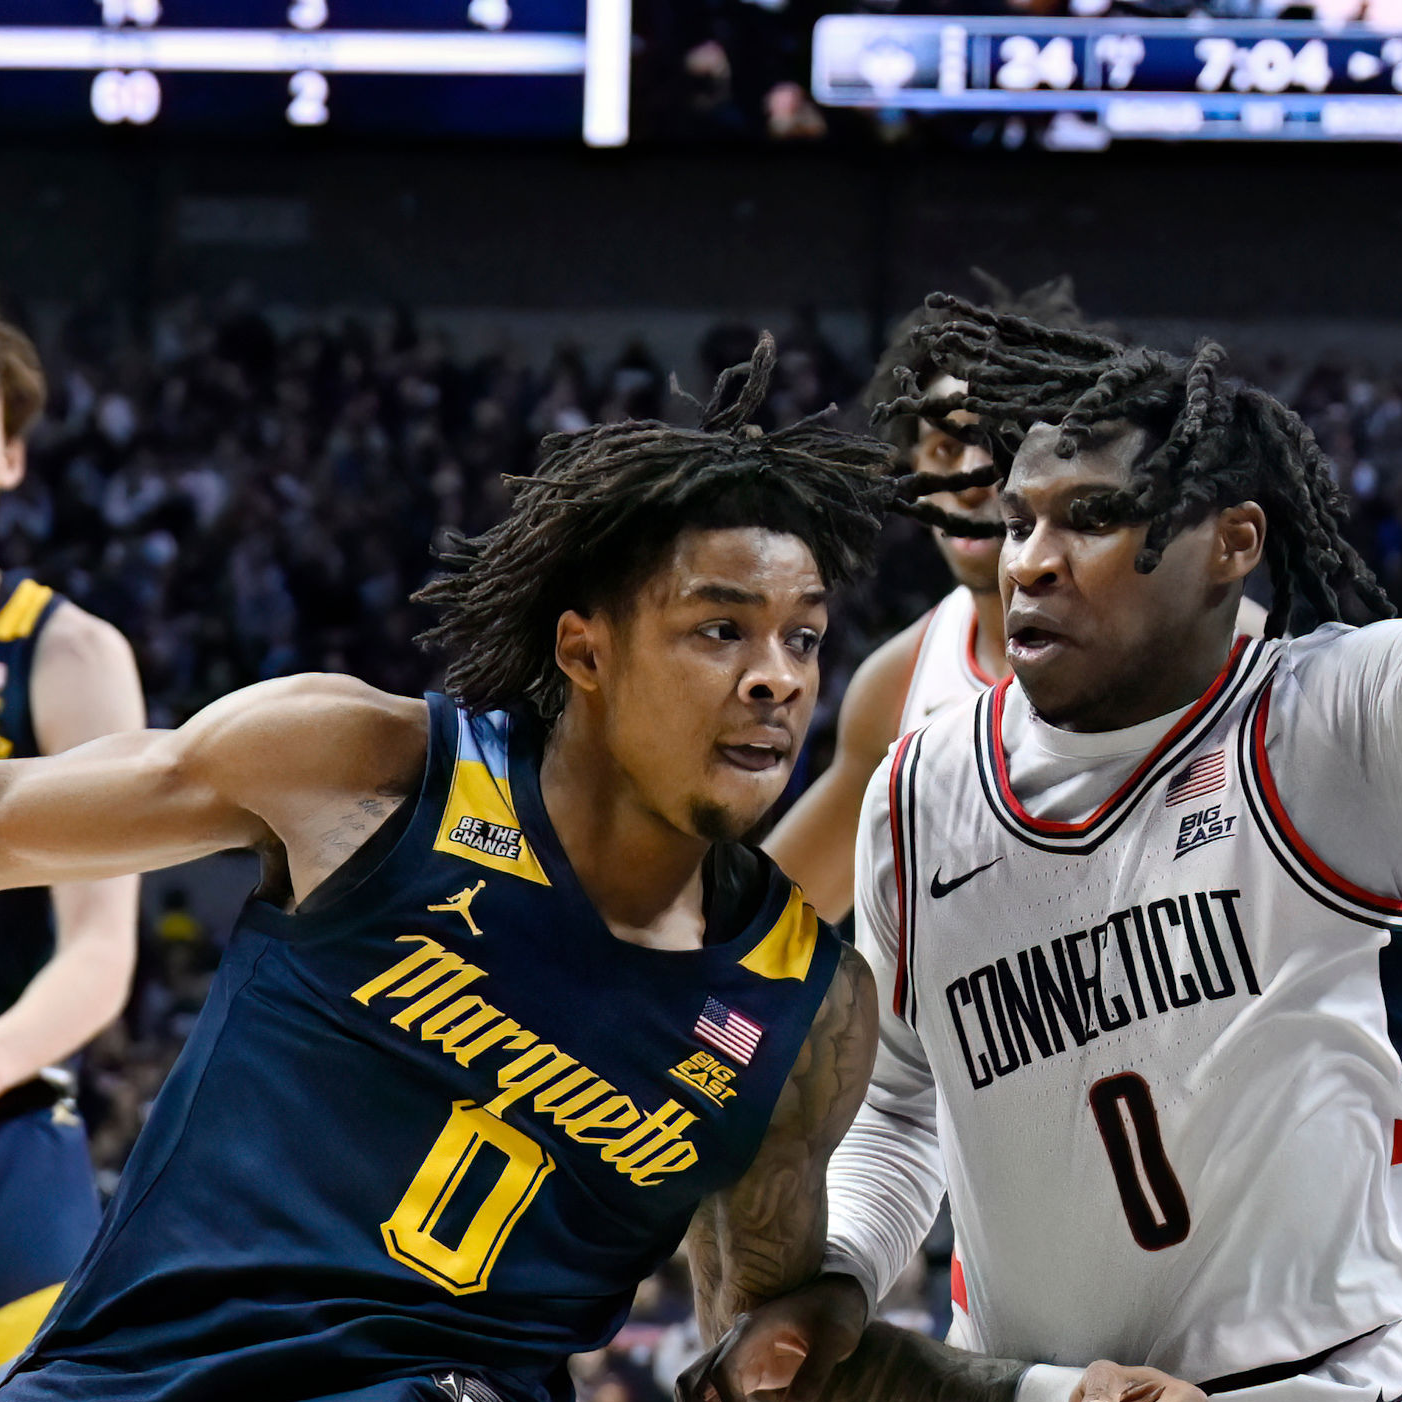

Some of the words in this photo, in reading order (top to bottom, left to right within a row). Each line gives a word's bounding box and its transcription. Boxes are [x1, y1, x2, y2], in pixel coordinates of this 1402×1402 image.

[998, 36, 1078, 90] 24
[1195, 38, 1333, 94] 7:04
[459, 817, 484, 834] BE
[487, 824, 520, 845] THE
[1176, 815, 1237, 850] EAST
[1179, 803, 1222, 833] BIG
[450, 828, 519, 858] CHANGE
[945, 889, 1262, 1090] CONNECTICUT
[351, 935, 700, 1187] Marquette
[676, 1060, 738, 1101] EAST
[689, 1051, 737, 1083] BIG
[1089, 1071, 1190, 1251] 0
[380, 1100, 556, 1297] 0
